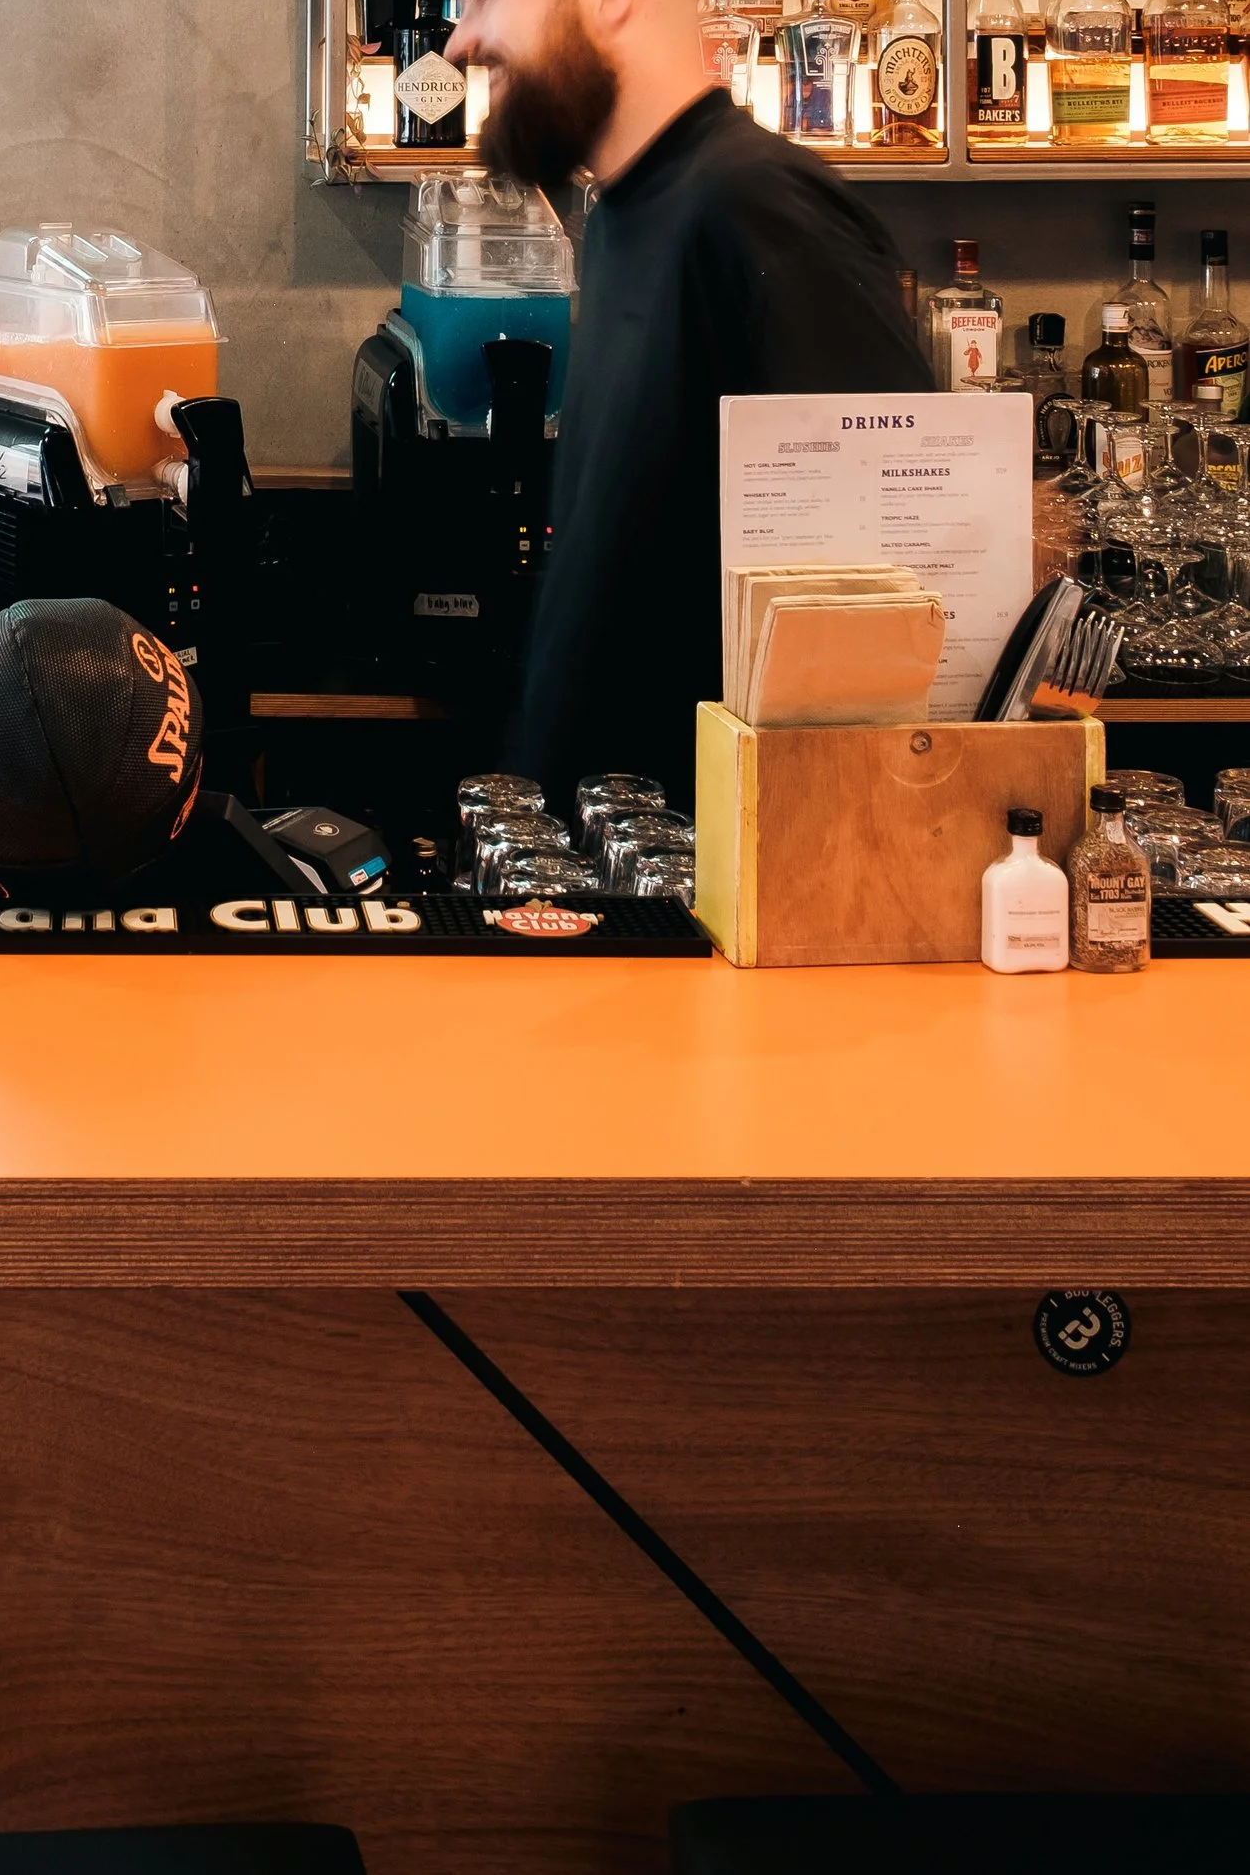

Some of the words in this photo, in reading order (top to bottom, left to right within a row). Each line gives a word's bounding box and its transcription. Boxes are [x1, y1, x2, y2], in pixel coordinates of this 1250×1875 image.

[991, 37, 1016, 100] B
[397, 81, 465, 92] HENDRICK'S
[884, 87, 932, 111] BOURBON
[978, 109, 1021, 122] BAKER'S
[951, 316, 997, 330] BEEFEATER
[1205, 353, 1247, 374] APERO
[841, 414, 916, 430] DRINKS
[881, 468, 951, 477] MILKSHAKES
[1091, 876, 1125, 889] MOUNT
[1127, 876, 1146, 889] GAY
[1100, 889, 1120, 900] 1703
[209, 899, 423, 933] Club
[482, 909, 599, 926] Havana
[511, 920, 578, 931] Club
[1048, 1347, 1069, 1365] CRAFT
[1069, 1361, 1098, 1371] MIXERS
